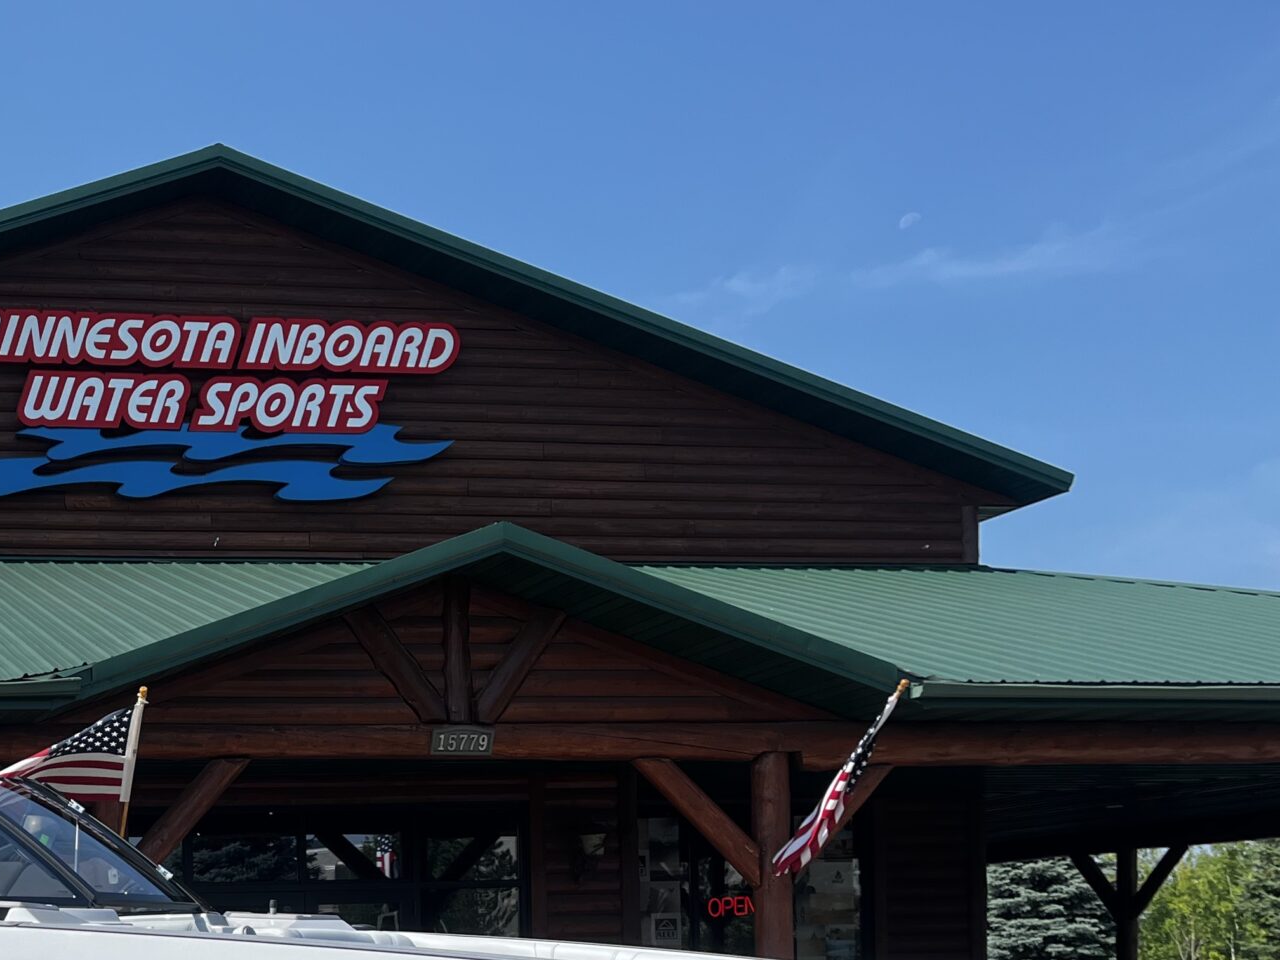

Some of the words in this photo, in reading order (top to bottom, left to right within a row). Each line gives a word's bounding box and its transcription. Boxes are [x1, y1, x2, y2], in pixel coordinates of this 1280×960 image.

[246, 322, 456, 369] INBOARD
[22, 374, 186, 424] WATER
[196, 382, 380, 428] SPORTS
[437, 734, 489, 751] 15779
